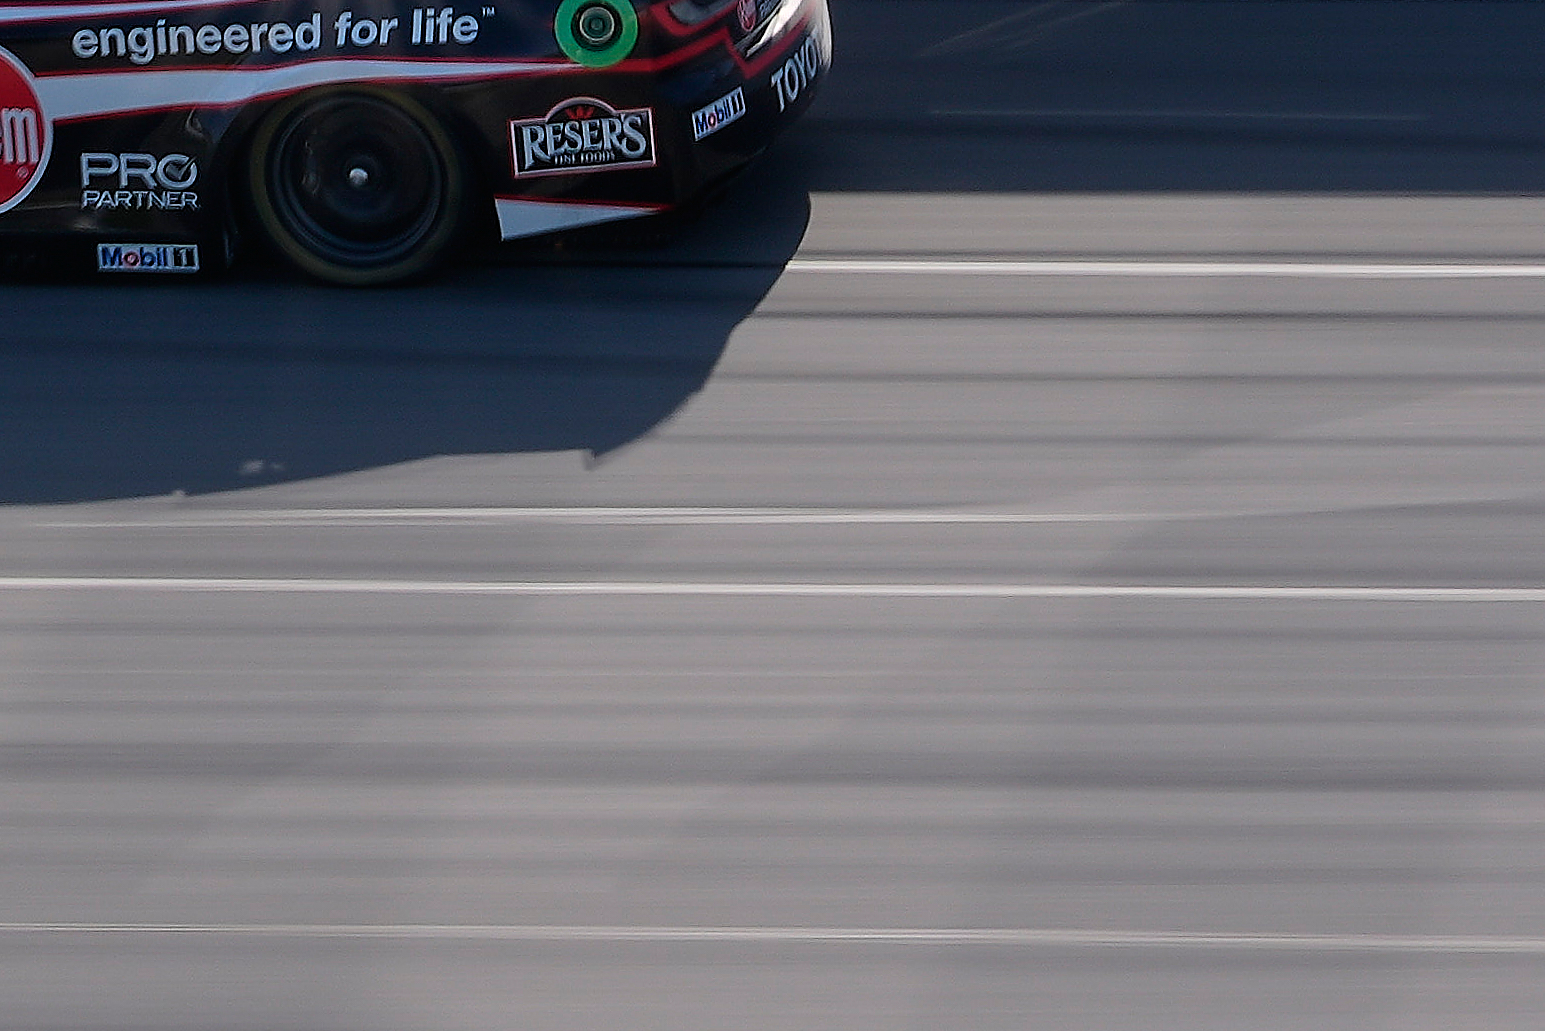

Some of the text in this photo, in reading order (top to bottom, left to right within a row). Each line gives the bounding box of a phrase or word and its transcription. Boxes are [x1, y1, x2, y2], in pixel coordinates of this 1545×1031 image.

[71, 13, 321, 65] engineered
[334, 11, 398, 48] for
[771, 34, 822, 113] TOYO
[694, 96, 731, 135] Mobil
[521, 114, 647, 170] RESER'S
[80, 152, 199, 190] PRO
[81, 190, 199, 210] PARTNER
[101, 246, 168, 267] Mobil
